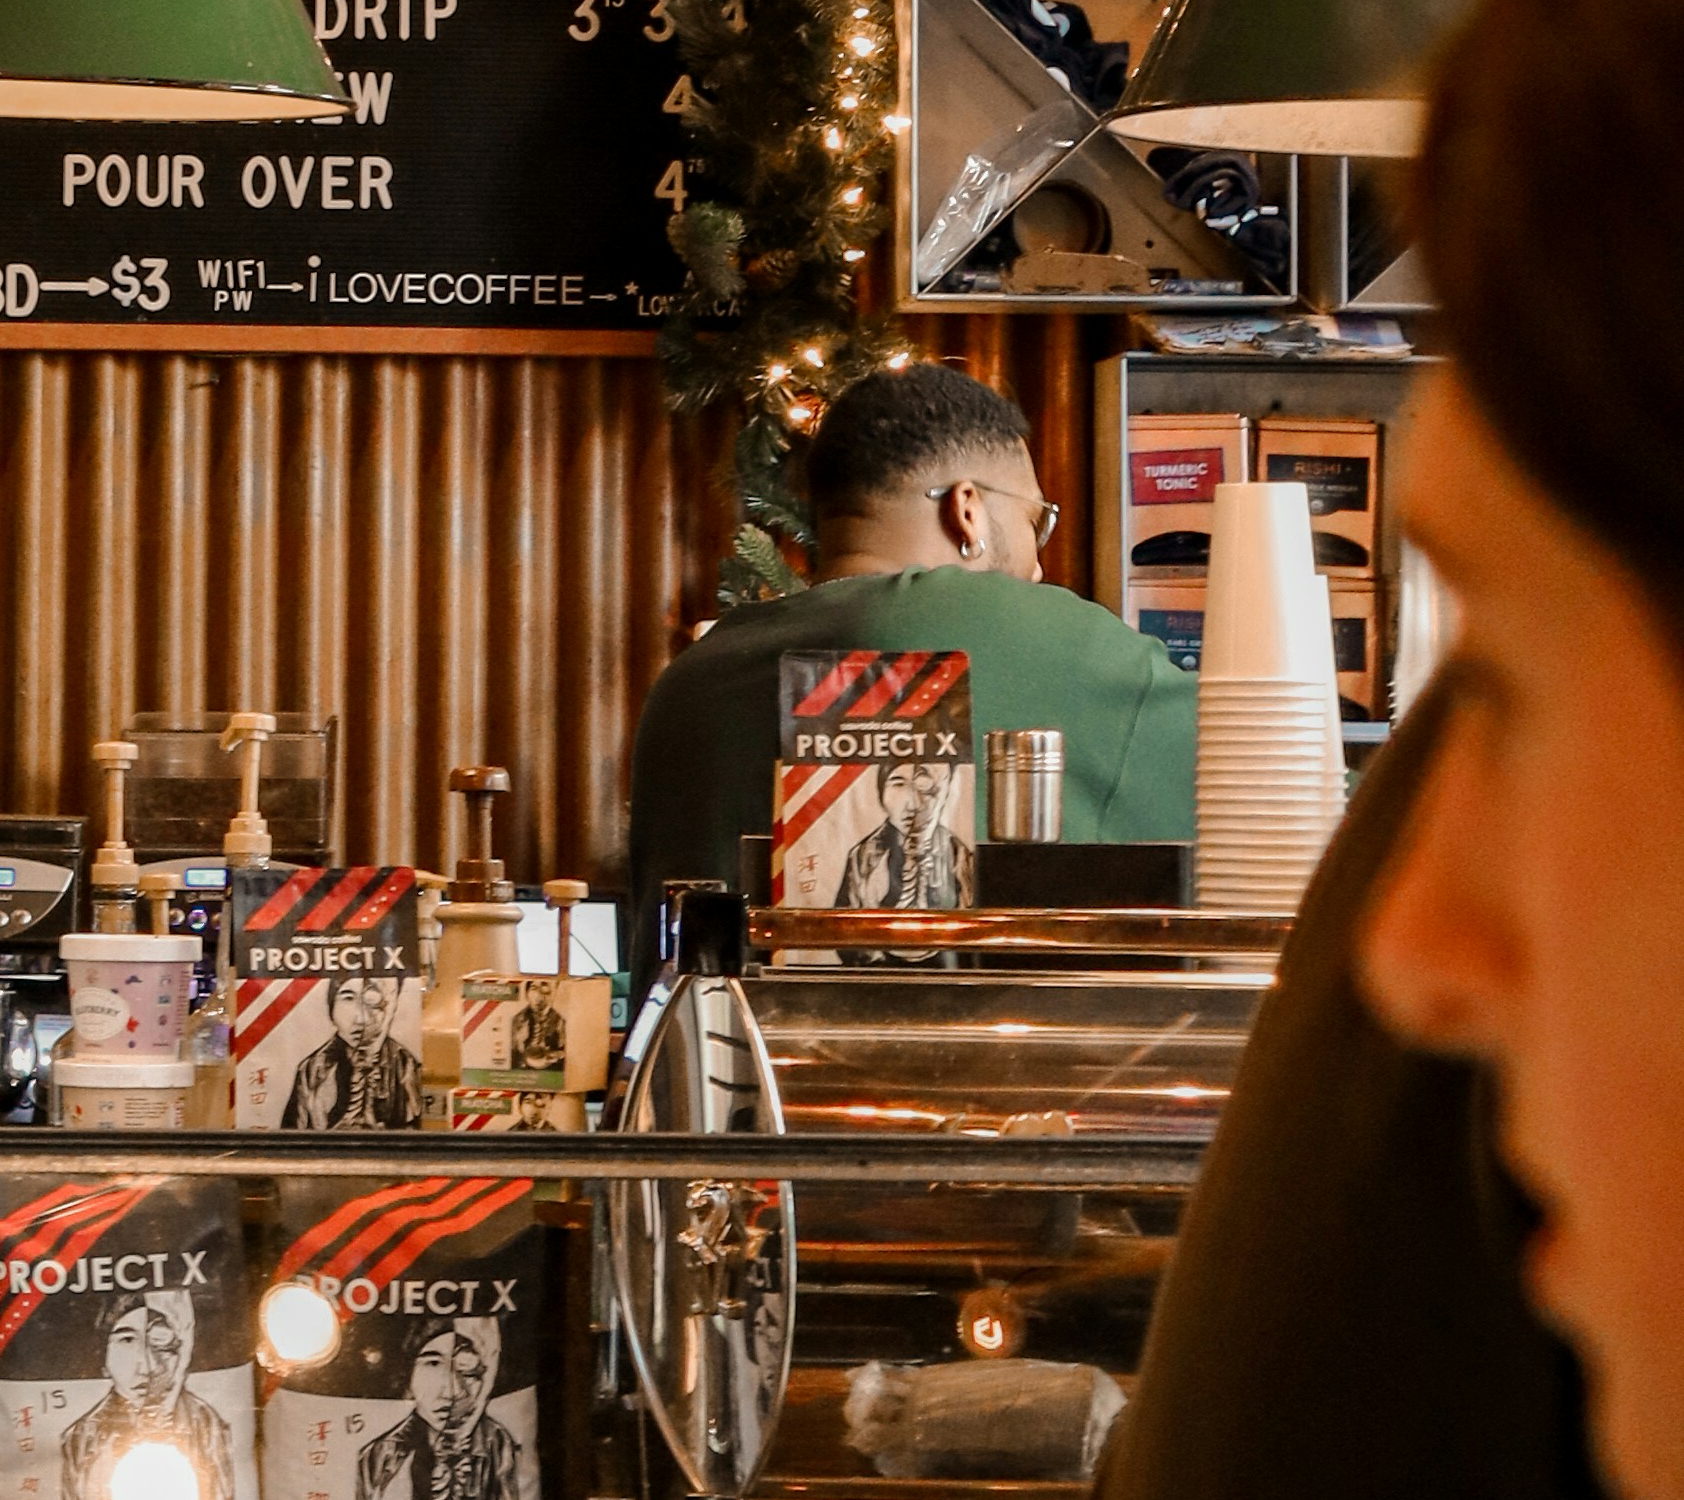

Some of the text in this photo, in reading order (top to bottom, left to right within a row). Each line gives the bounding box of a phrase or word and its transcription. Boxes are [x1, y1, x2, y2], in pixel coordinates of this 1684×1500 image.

[63, 154, 204, 207] POUR
[242, 156, 392, 209] OVER
[214, 291, 252, 311] PW
[1144, 462, 1208, 478] TURMERIC
[1156, 477, 1198, 491] TONIC
[796, 732, 958, 758] PROJECT X
[249, 946, 405, 972] PROJECT X
[182, 1250, 208, 1286] X
[492, 1279, 518, 1312] X
[345, 1413, 366, 1435] 15
